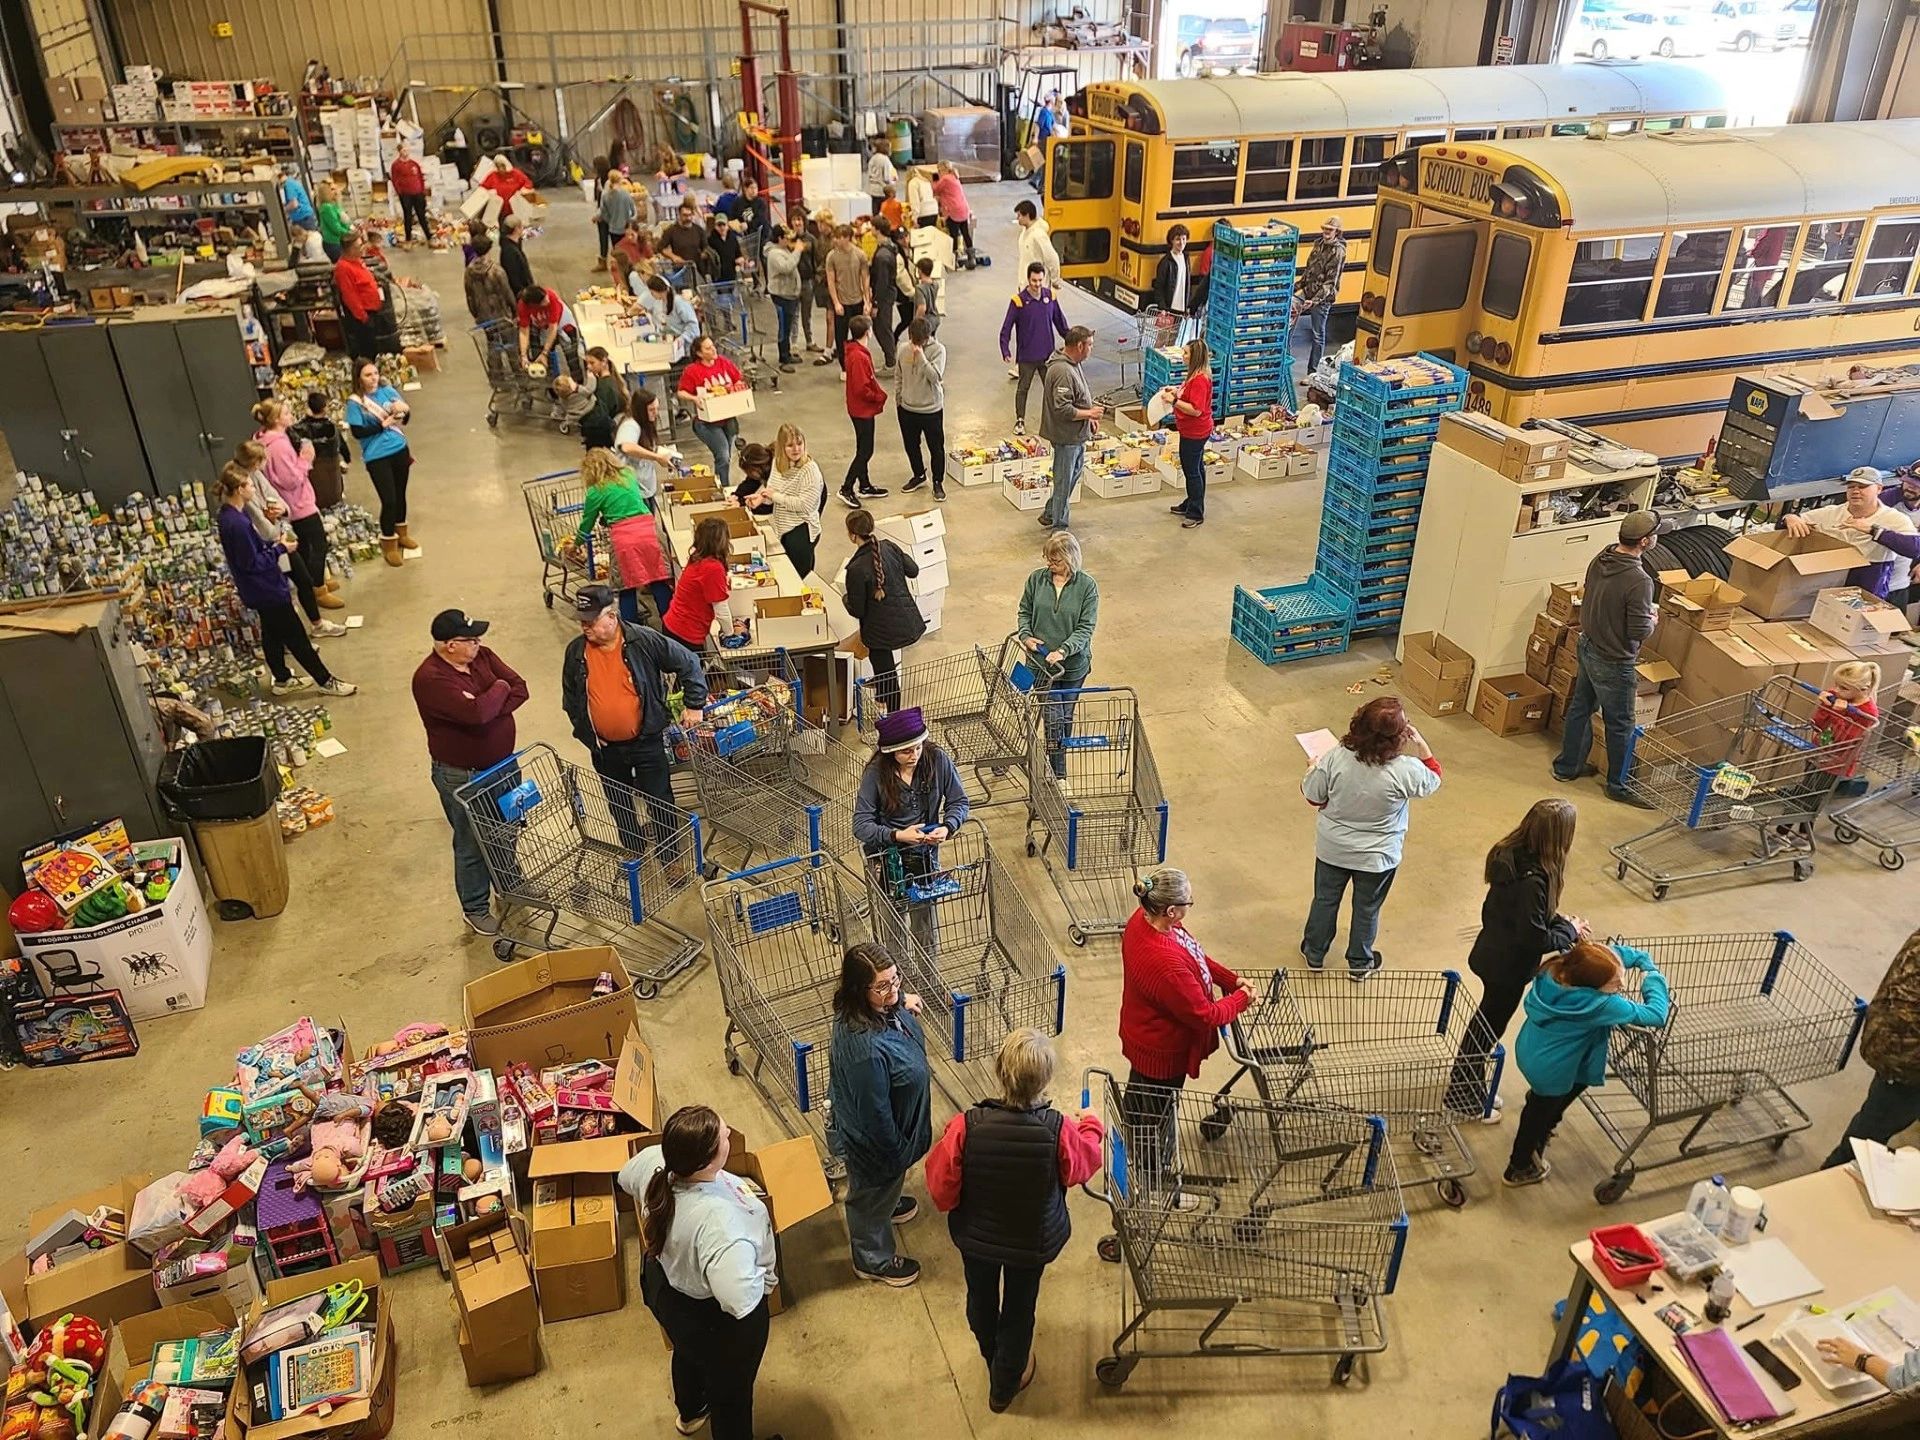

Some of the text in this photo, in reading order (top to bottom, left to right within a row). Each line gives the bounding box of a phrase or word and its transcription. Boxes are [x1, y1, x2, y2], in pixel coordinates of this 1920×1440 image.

[1424, 161, 1495, 203] SCHOOL BUS
[1121, 261, 1132, 278] 412
[1464, 392, 1492, 417] 1489
[93, 923, 126, 938] FOLDING
[126, 915, 149, 927] CHAIR
